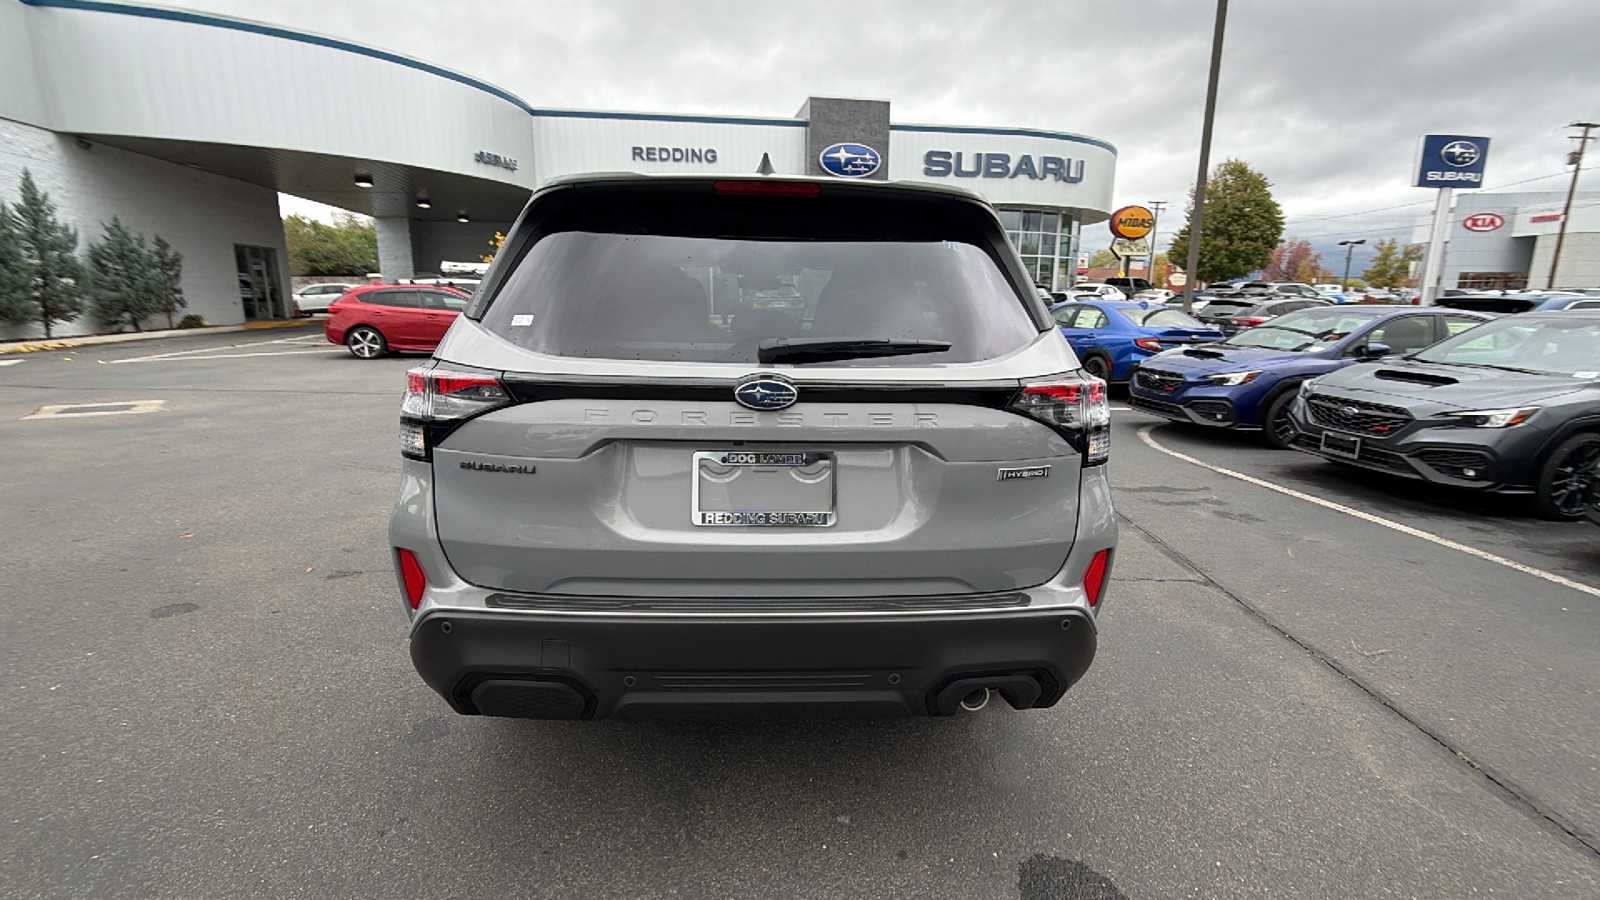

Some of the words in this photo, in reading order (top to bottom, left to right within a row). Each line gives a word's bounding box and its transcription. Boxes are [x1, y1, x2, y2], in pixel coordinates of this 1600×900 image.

[632, 146, 718, 164] REDDING
[923, 150, 1085, 184] SUBARU
[1426, 171, 1482, 183] SUBARU
[1117, 217, 1154, 229] MIDAS
[1471, 217, 1496, 228] KIA
[584, 408, 939, 428] FORESTER
[729, 454, 756, 463] DOG
[459, 461, 536, 474] SUBARU
[1007, 469, 1044, 478] HYBRID
[705, 513, 766, 524] REDDING
[769, 513, 824, 524] SUBARU
